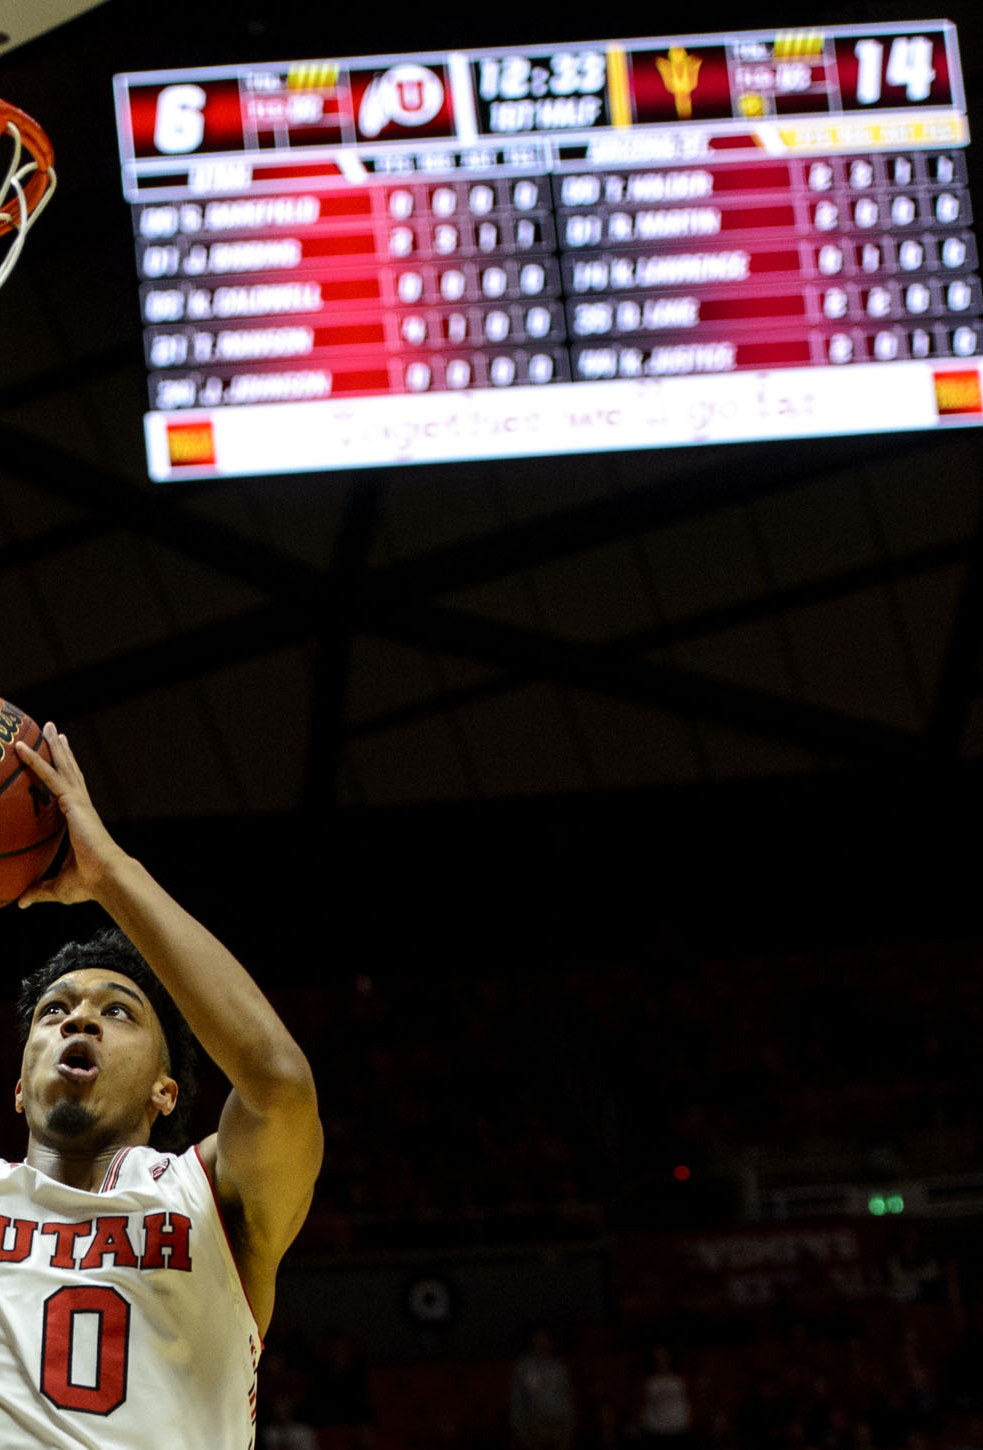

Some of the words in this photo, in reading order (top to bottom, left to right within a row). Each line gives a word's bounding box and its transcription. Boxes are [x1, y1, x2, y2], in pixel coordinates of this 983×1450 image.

[478, 50, 606, 100] 12:33
[854, 36, 937, 105] 14
[154, 84, 206, 154] 6
[39, 1284, 131, 1417] 0
